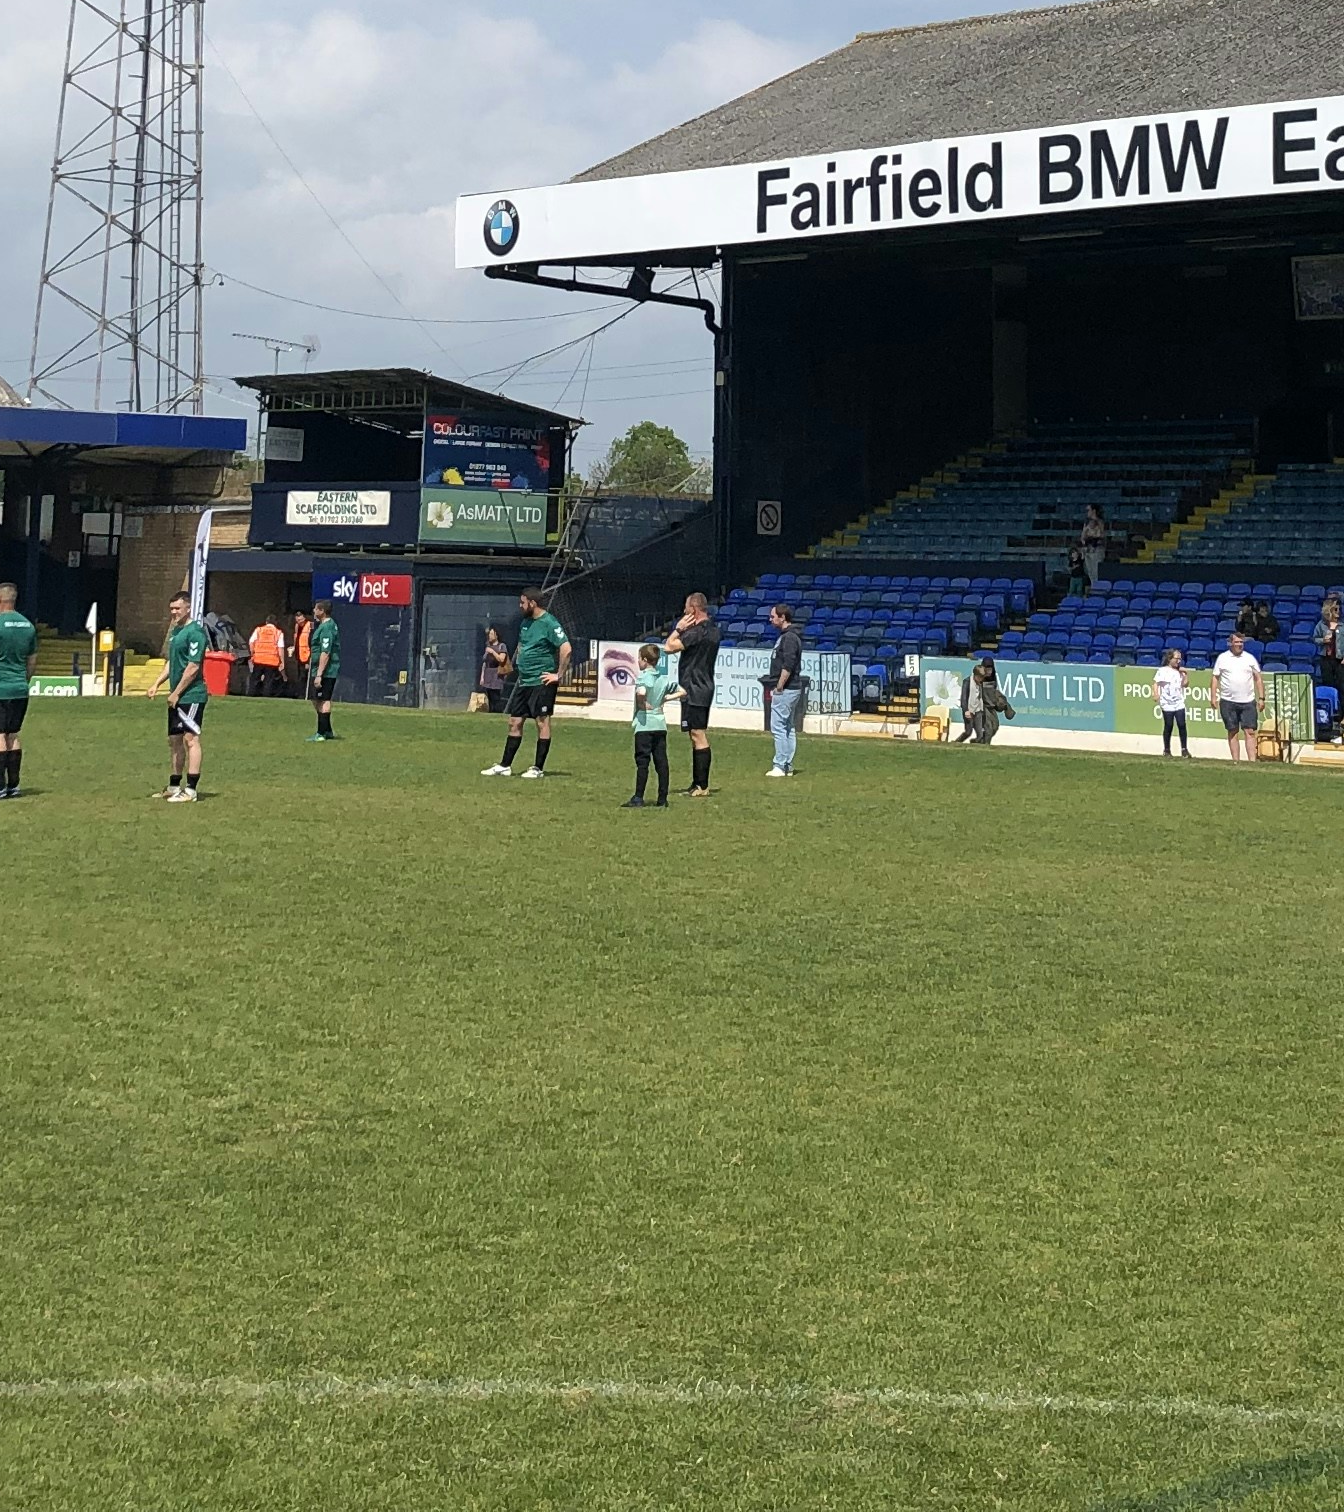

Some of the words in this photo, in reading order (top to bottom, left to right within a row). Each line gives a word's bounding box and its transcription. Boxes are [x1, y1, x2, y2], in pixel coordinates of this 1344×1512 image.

[756, 141, 1003, 233] Fairfield
[1039, 116, 1230, 205] BMW
[510, 427, 543, 440] PRINT
[317, 491, 358, 502] EASTERN
[296, 504, 358, 515] SCAFFOLDING
[360, 504, 377, 515] LTD
[456, 503, 513, 521] AsMATT
[516, 506, 542, 523] LTD
[333, 576, 358, 603] sky
[362, 576, 388, 598] bet
[738, 652, 770, 669] Priva
[908, 655, 915, 666] E
[909, 666, 915, 676] 2
[1063, 675, 1105, 703] LTD
